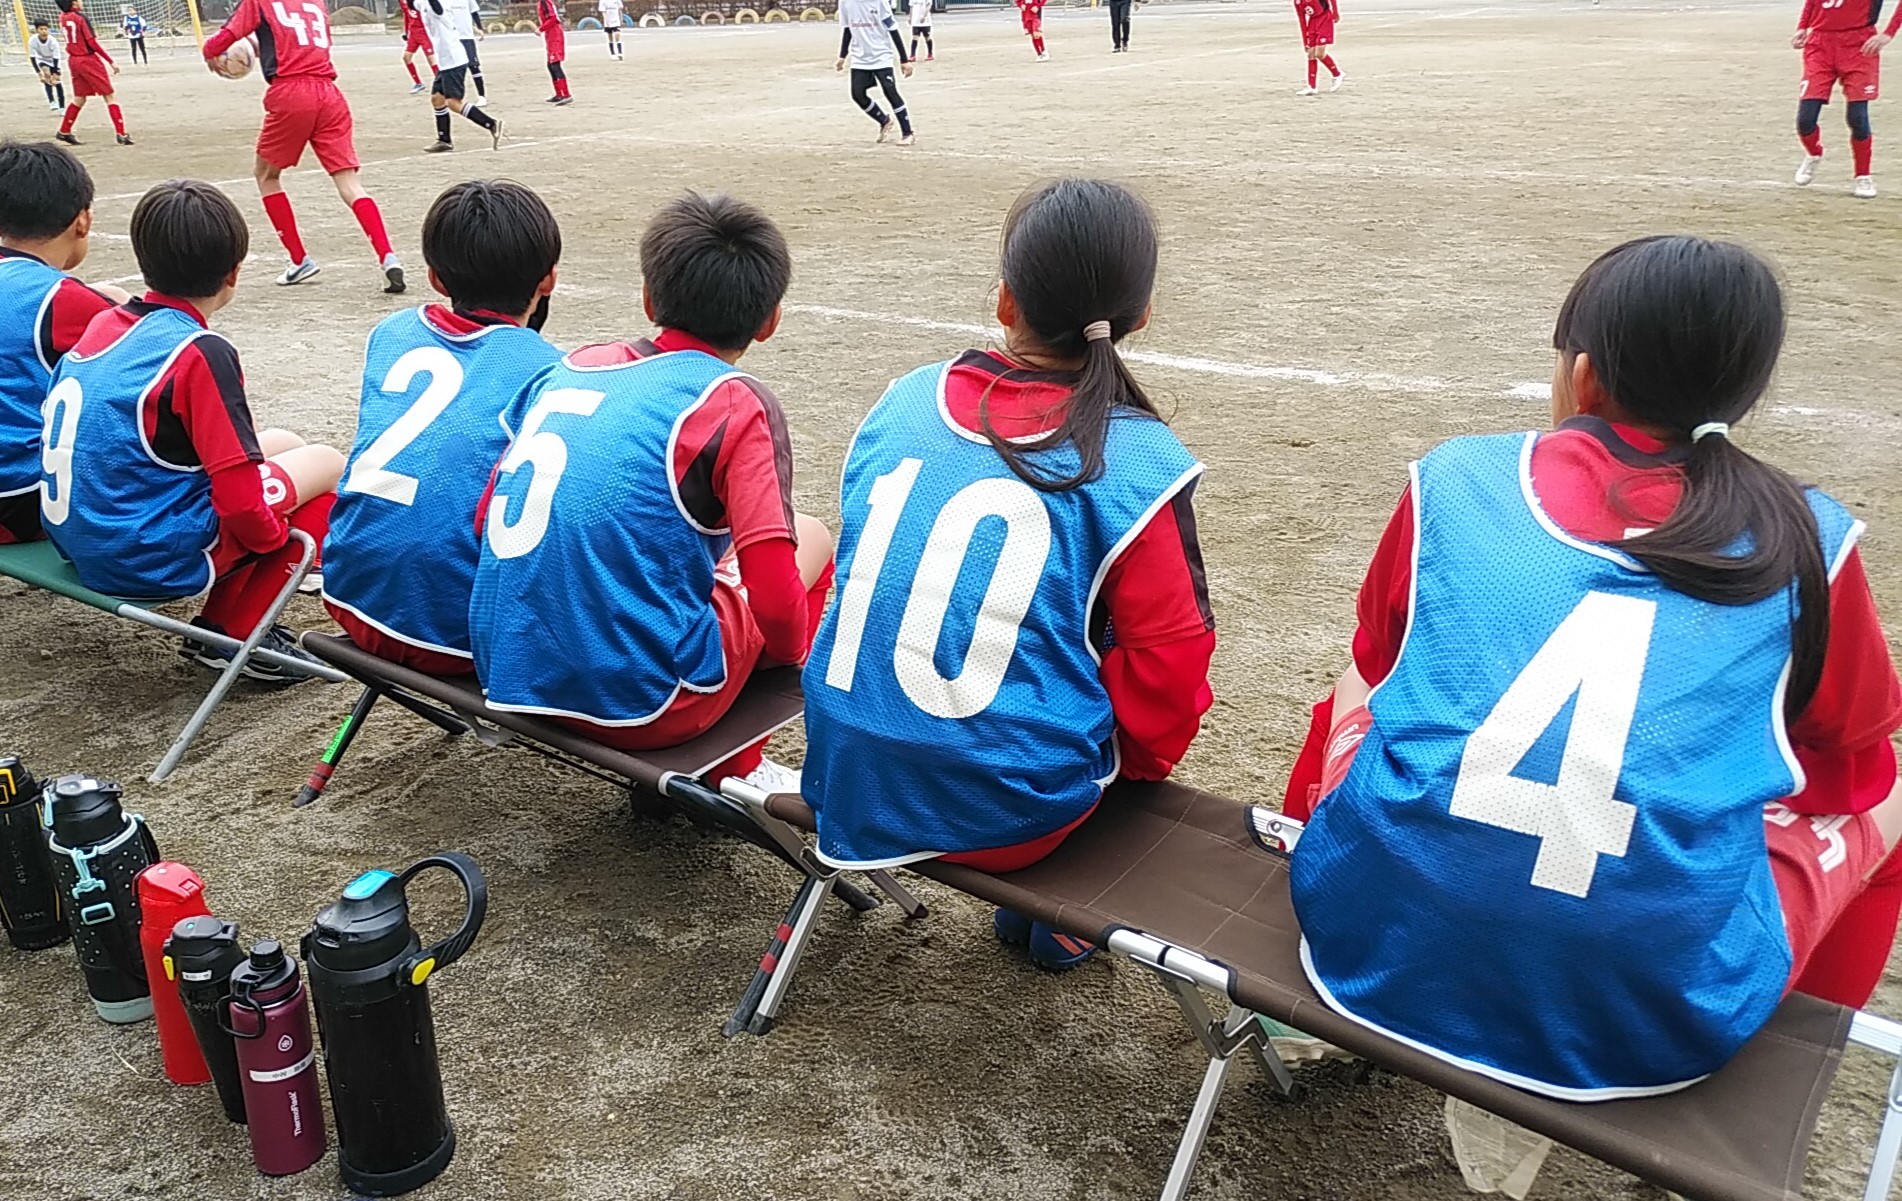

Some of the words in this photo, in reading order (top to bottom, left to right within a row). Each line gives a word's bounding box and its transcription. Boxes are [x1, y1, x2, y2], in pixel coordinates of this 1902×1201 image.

[271, 2, 329, 48] 43
[40, 377, 83, 526] 9
[344, 346, 464, 505] 2
[487, 387, 606, 559] 5
[826, 457, 1051, 718] 10
[1450, 591, 1657, 898] 4
[287, 1091, 302, 1137] ThermoFlask
